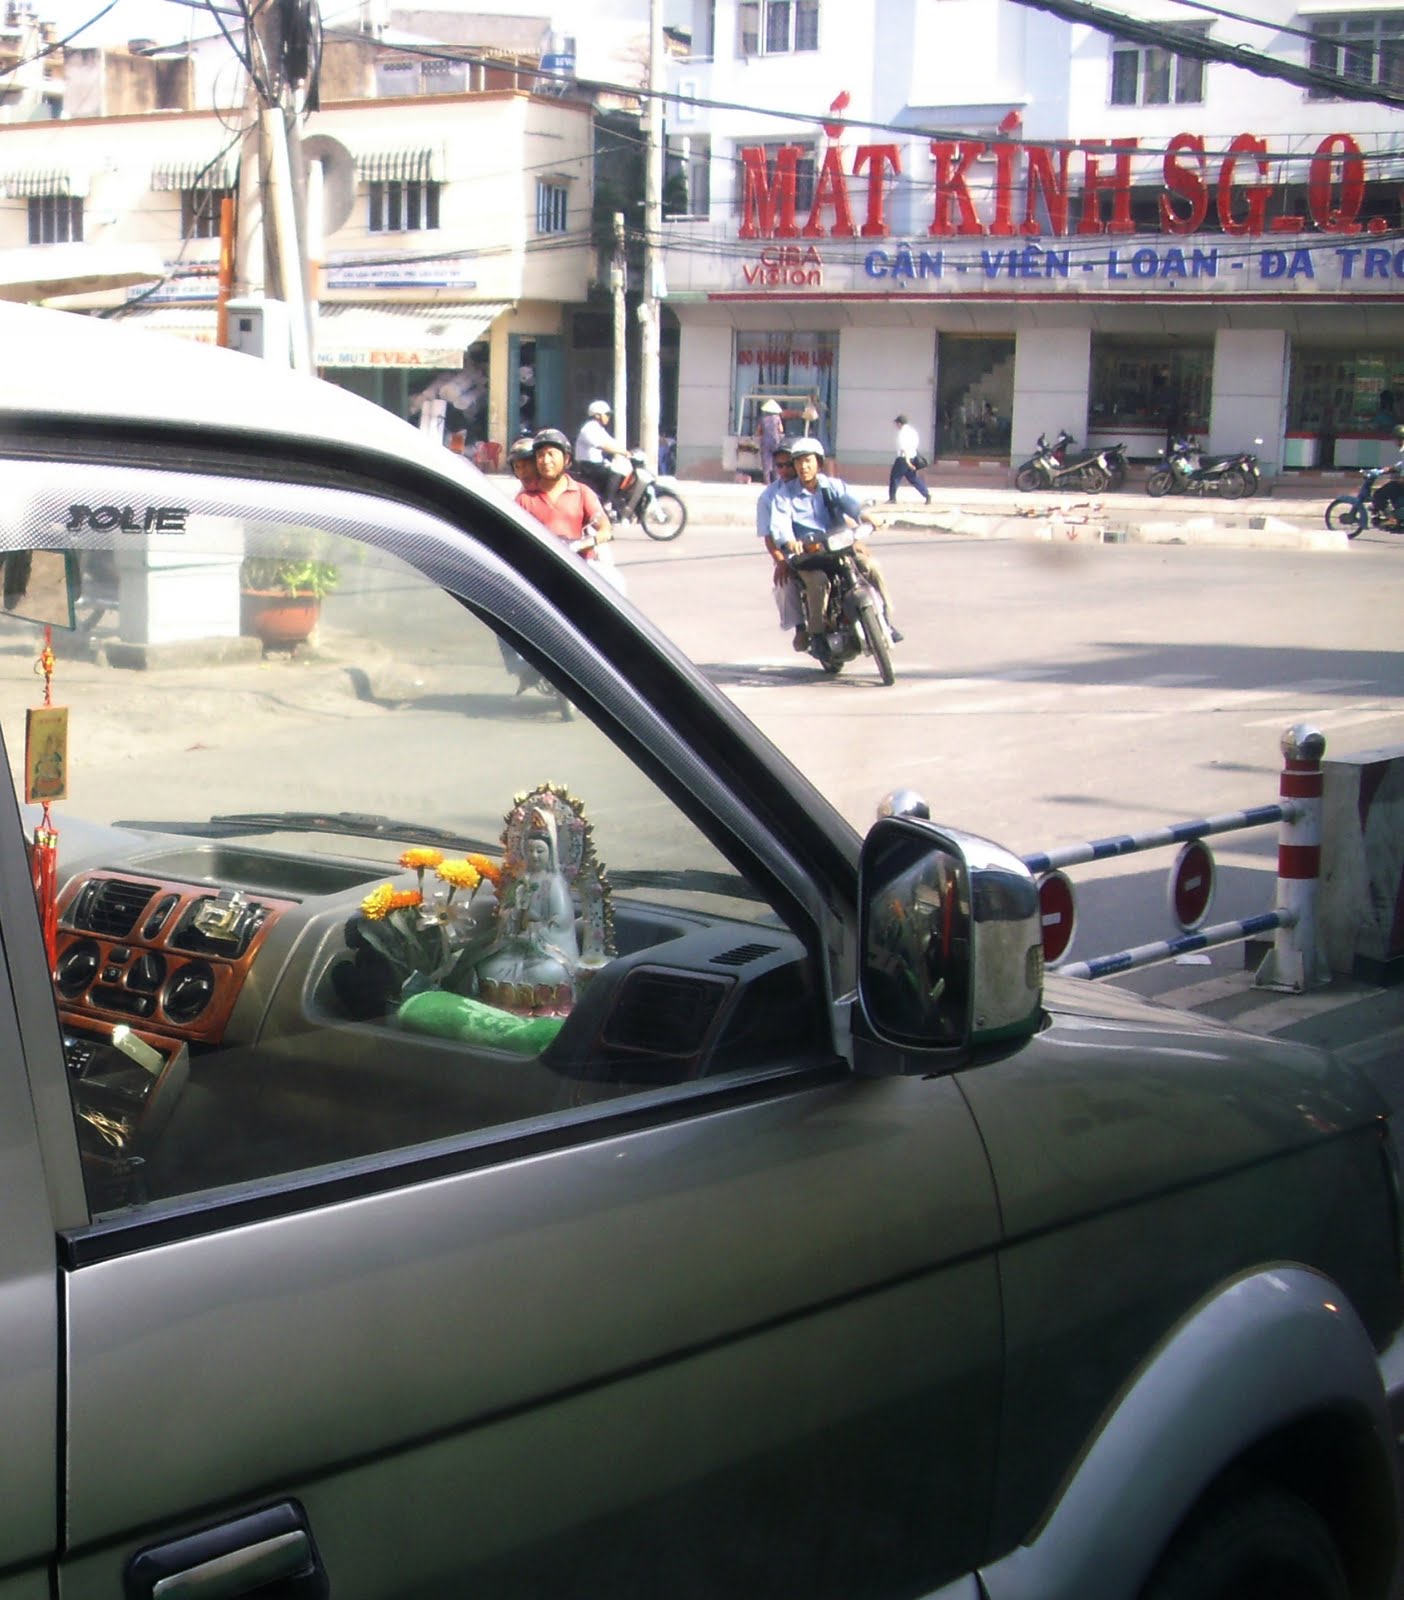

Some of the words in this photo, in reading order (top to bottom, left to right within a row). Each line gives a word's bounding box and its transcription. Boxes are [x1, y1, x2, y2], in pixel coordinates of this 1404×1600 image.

[761, 245, 823, 267] CIBA
[865, 241, 946, 288] CẬN
[1108, 248, 1219, 288] LOẠN
[1260, 249, 1316, 279] ĐA
